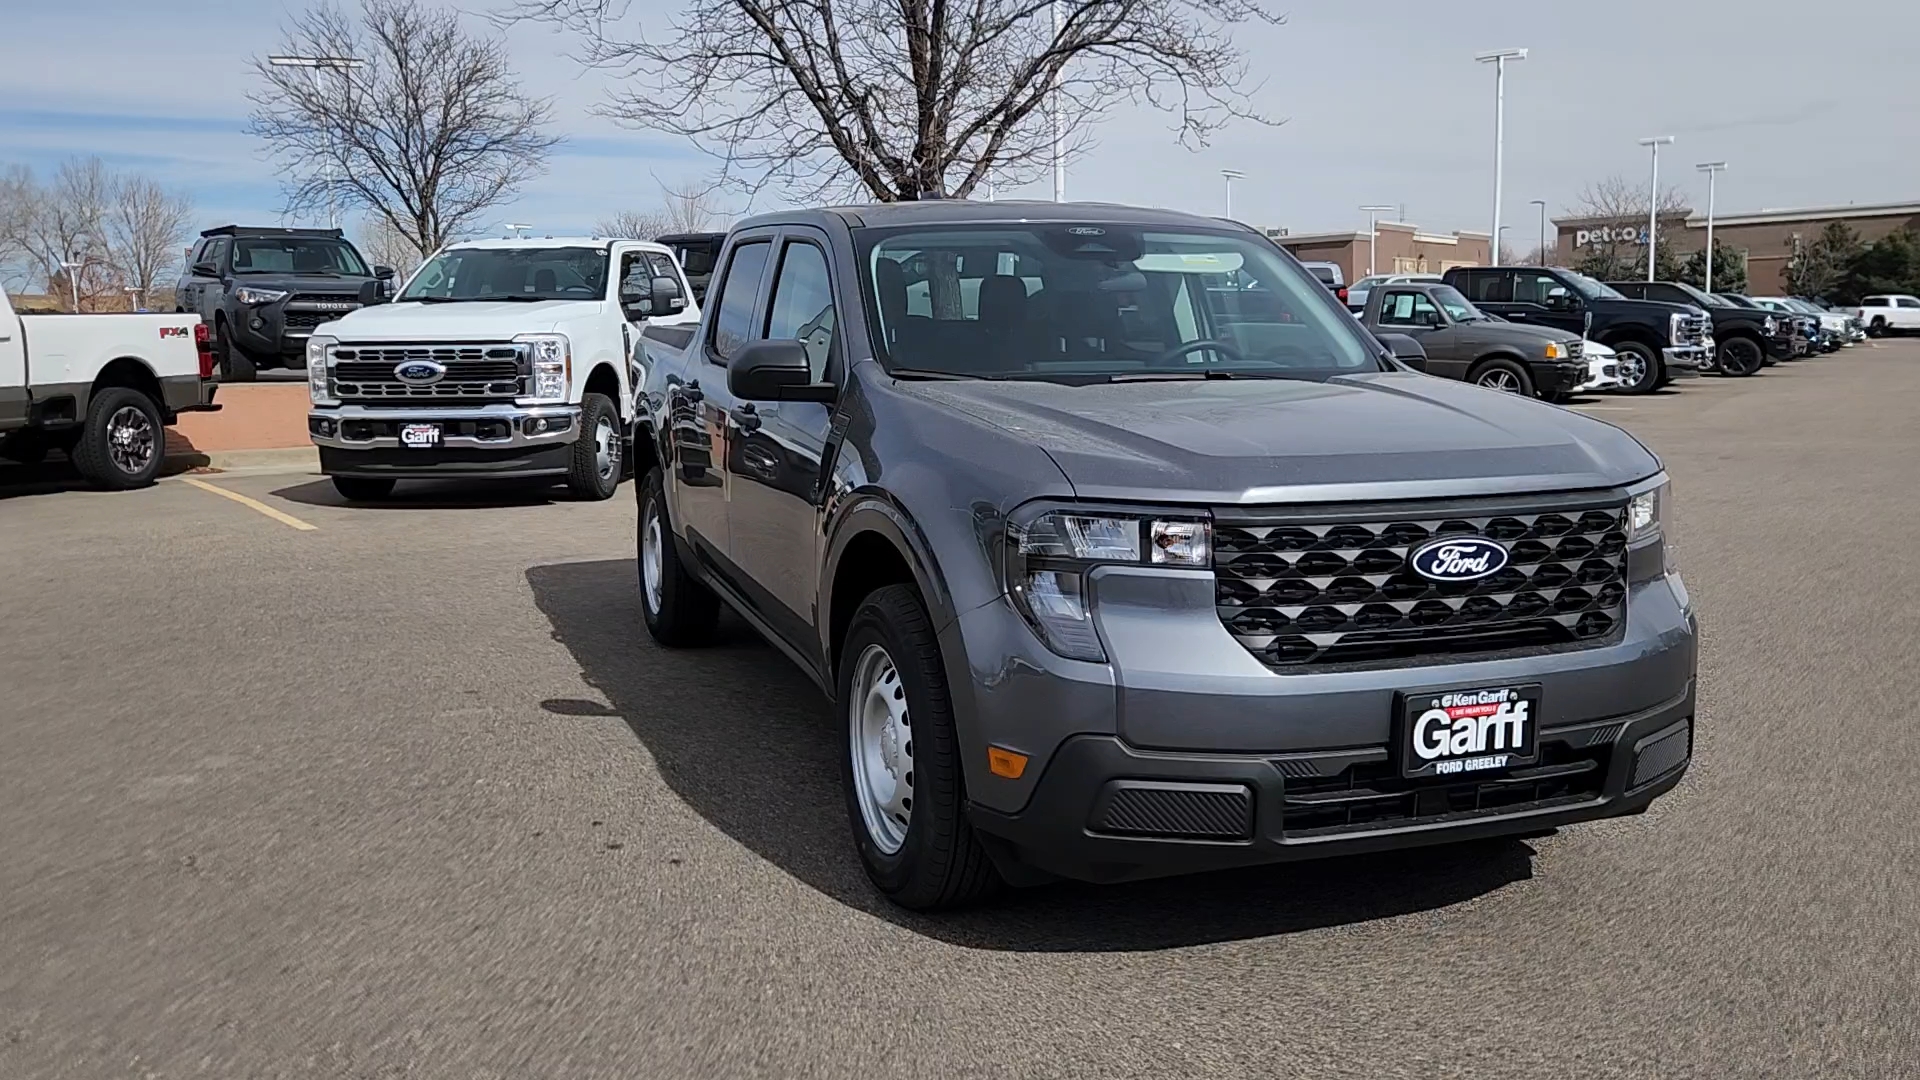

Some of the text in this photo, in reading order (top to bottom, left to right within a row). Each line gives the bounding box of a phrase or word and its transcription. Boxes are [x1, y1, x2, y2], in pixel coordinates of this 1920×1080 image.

[1576, 226, 1637, 248] petco
[159, 327, 188, 339] FX4
[402, 428, 440, 443] Garff
[1431, 545, 1491, 575] Ford
[1453, 693, 1478, 707] Ken
[1478, 689, 1509, 705] Garff
[1413, 701, 1529, 760] Garff
[1436, 756, 1509, 775] FORD GREELEY
